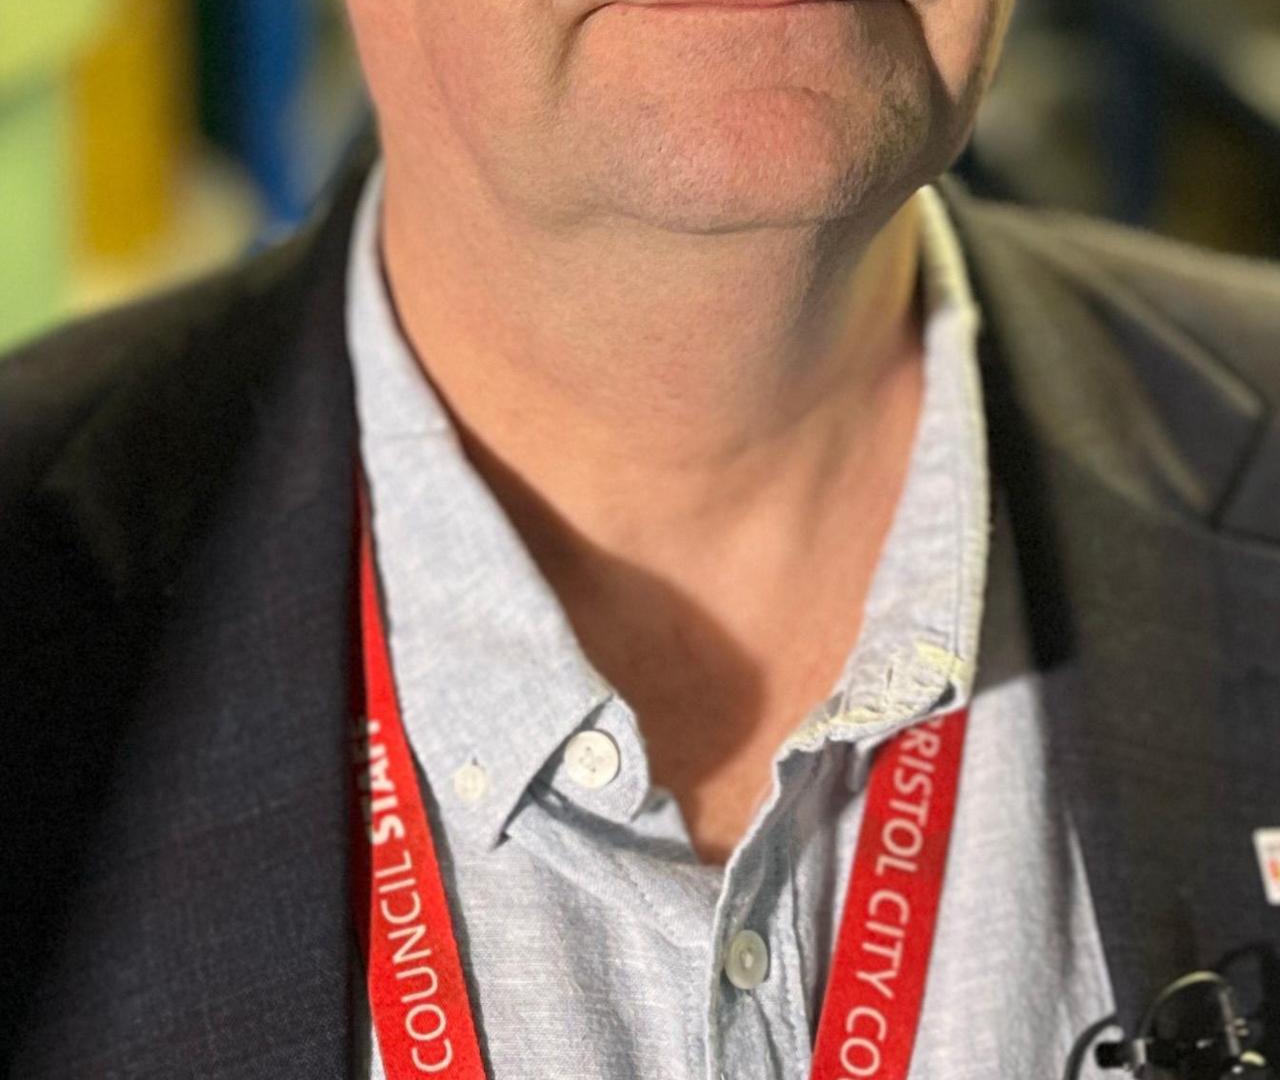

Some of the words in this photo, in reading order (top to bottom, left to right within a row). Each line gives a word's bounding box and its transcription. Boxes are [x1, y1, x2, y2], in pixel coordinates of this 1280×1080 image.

[374, 849, 454, 1073] COUNCIL
[856, 889, 910, 1001] CITY
[839, 1005, 888, 1080] CO
